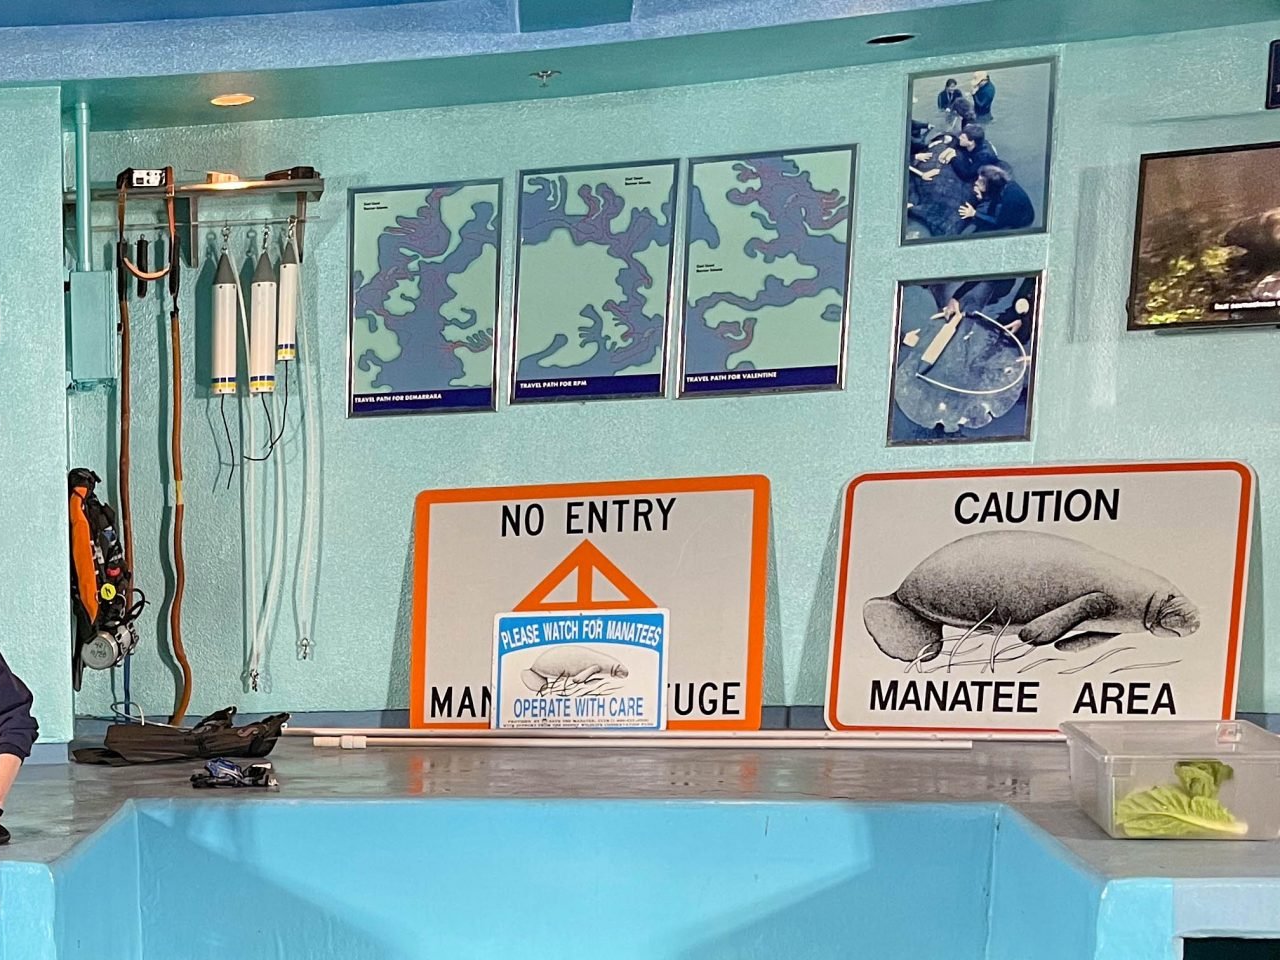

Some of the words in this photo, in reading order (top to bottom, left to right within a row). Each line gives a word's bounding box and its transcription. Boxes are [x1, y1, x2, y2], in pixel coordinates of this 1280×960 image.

[501, 504, 544, 537] NO
[567, 498, 676, 534] ENTRY
[954, 488, 1119, 524] CAUTION
[501, 624, 539, 649] PLEASE
[543, 620, 578, 641] WATCH
[583, 620, 602, 639] FOR
[606, 622, 662, 646] MANATEES
[514, 698, 570, 717] OPERATE
[575, 698, 605, 717] WITH
[609, 697, 643, 716] CARE
[666, 682, 740, 715] UGE
[870, 680, 1039, 712] MANATEE
[1073, 682, 1176, 715] AREA
